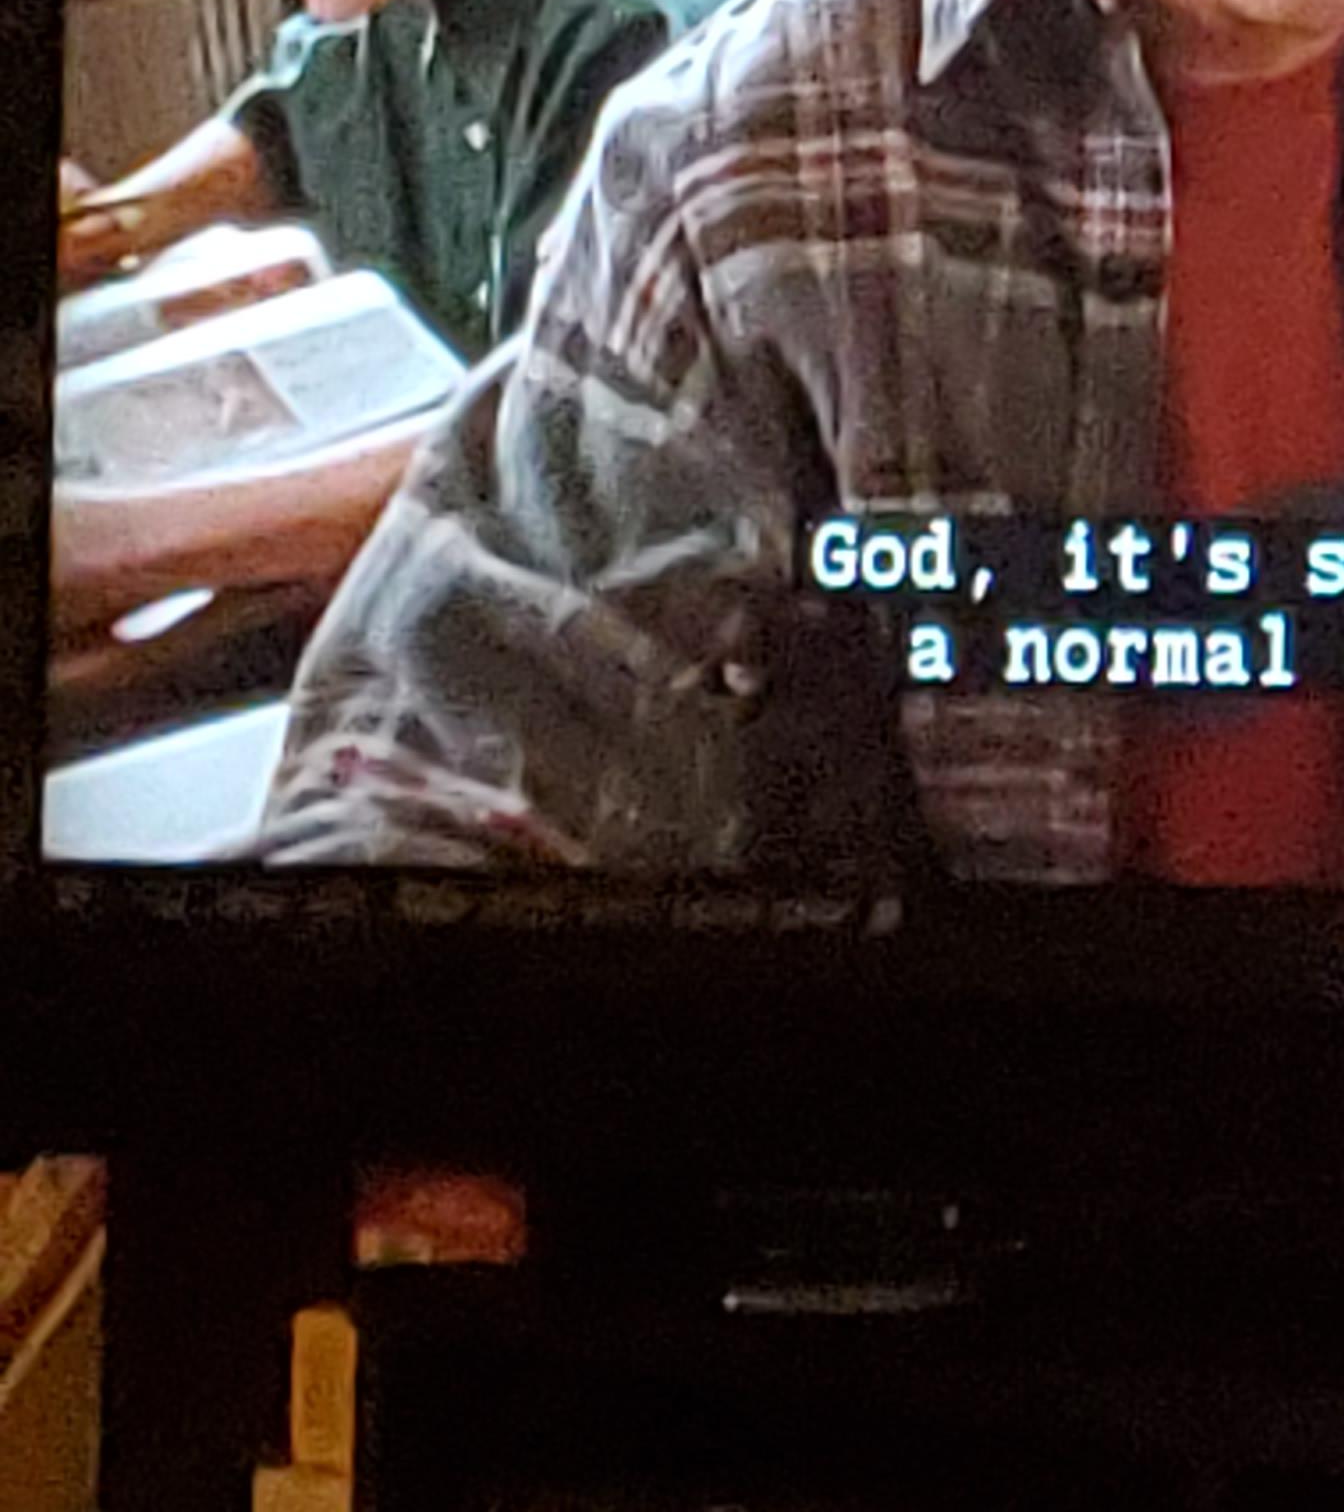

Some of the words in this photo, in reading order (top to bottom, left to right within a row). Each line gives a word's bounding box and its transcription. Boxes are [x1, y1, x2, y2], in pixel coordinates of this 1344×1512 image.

[809, 519, 994, 603] God,
[1062, 520, 1252, 593] it's
[907, 626, 954, 683] a
[1003, 614, 1297, 687] normal
